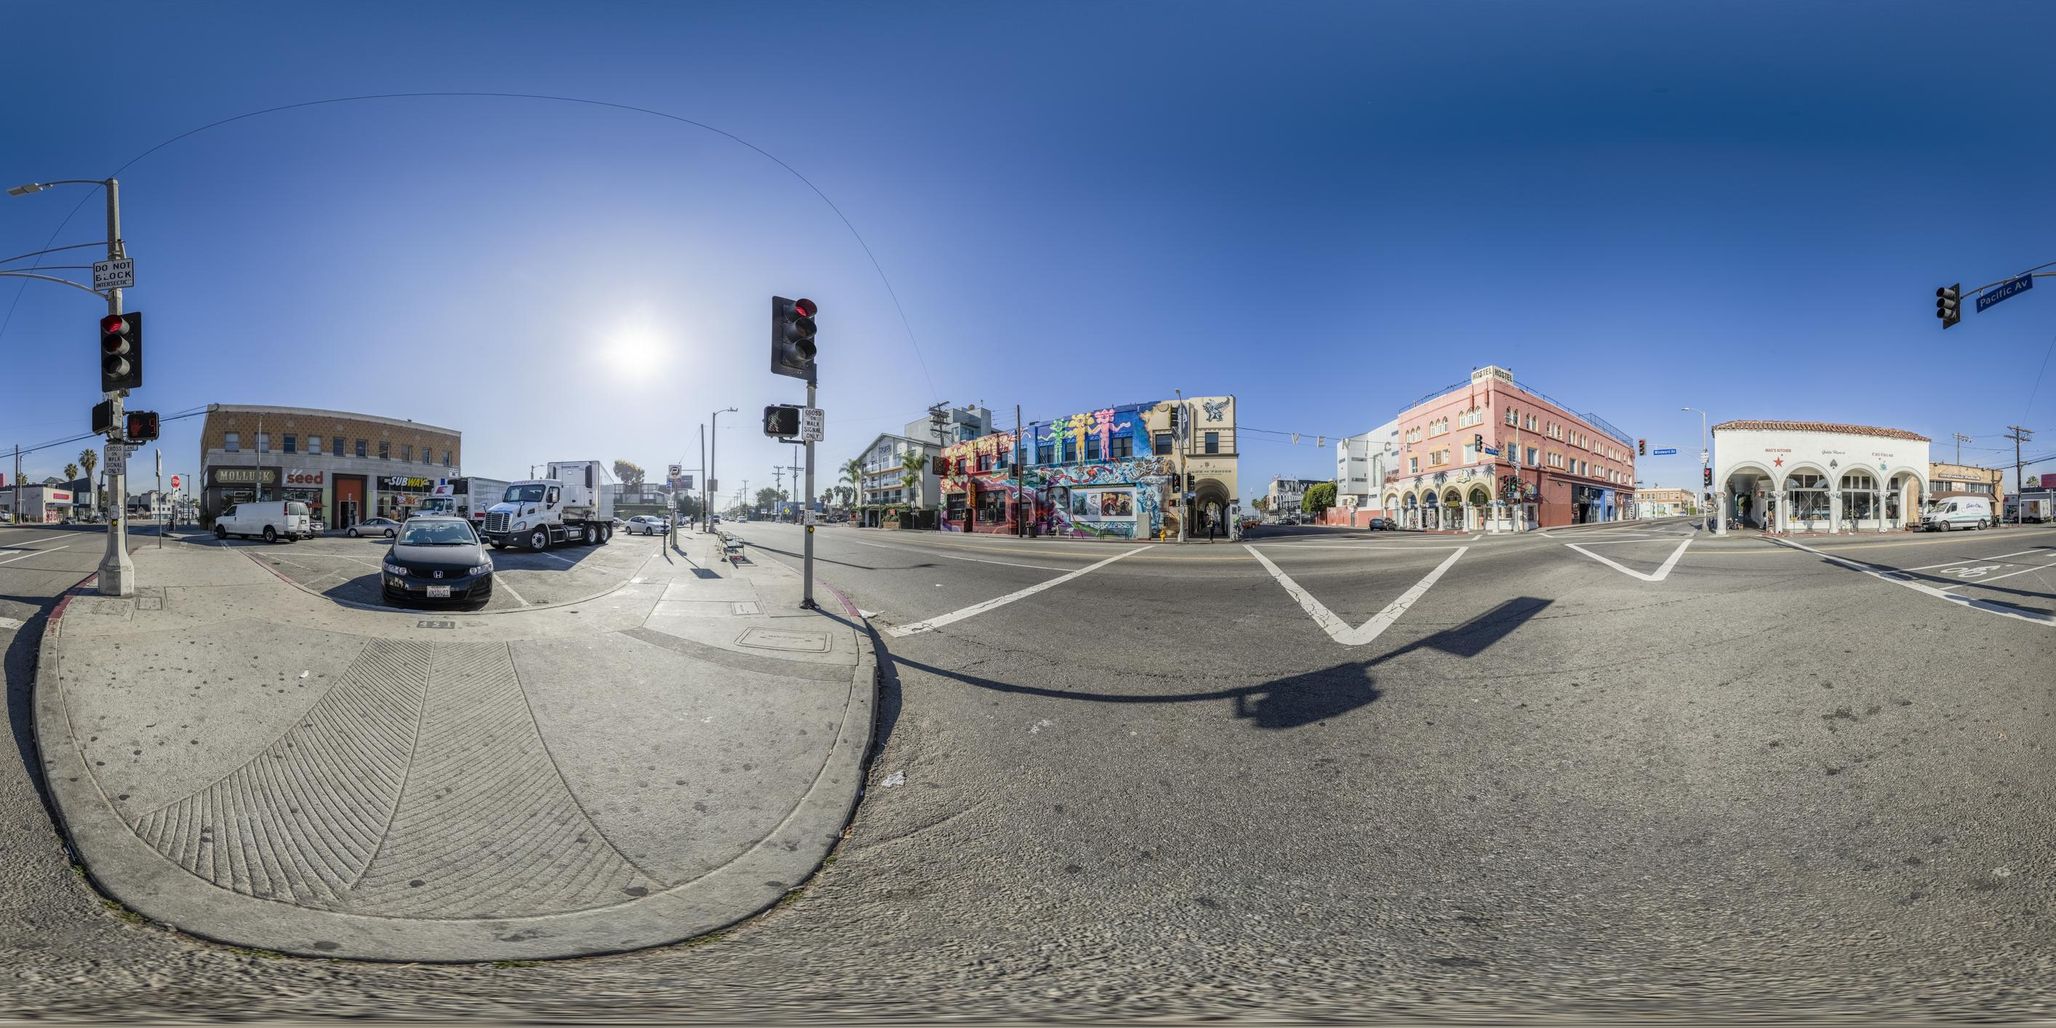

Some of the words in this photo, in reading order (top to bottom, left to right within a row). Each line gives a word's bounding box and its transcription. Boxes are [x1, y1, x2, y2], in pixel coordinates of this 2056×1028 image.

[95, 264, 108, 272] DO
[113, 261, 131, 270] NOT
[95, 271, 132, 282] BLOCK
[1980, 287, 2012, 307] Pacific
[2015, 280, 2028, 291] Av
[1472, 368, 1492, 380] HOSTEL
[1494, 367, 1513, 383] HOSTEL
[1292, 432, 1413, 453] VENICE
[287, 471, 323, 485] seed
[389, 476, 425, 488] SUBWAY
